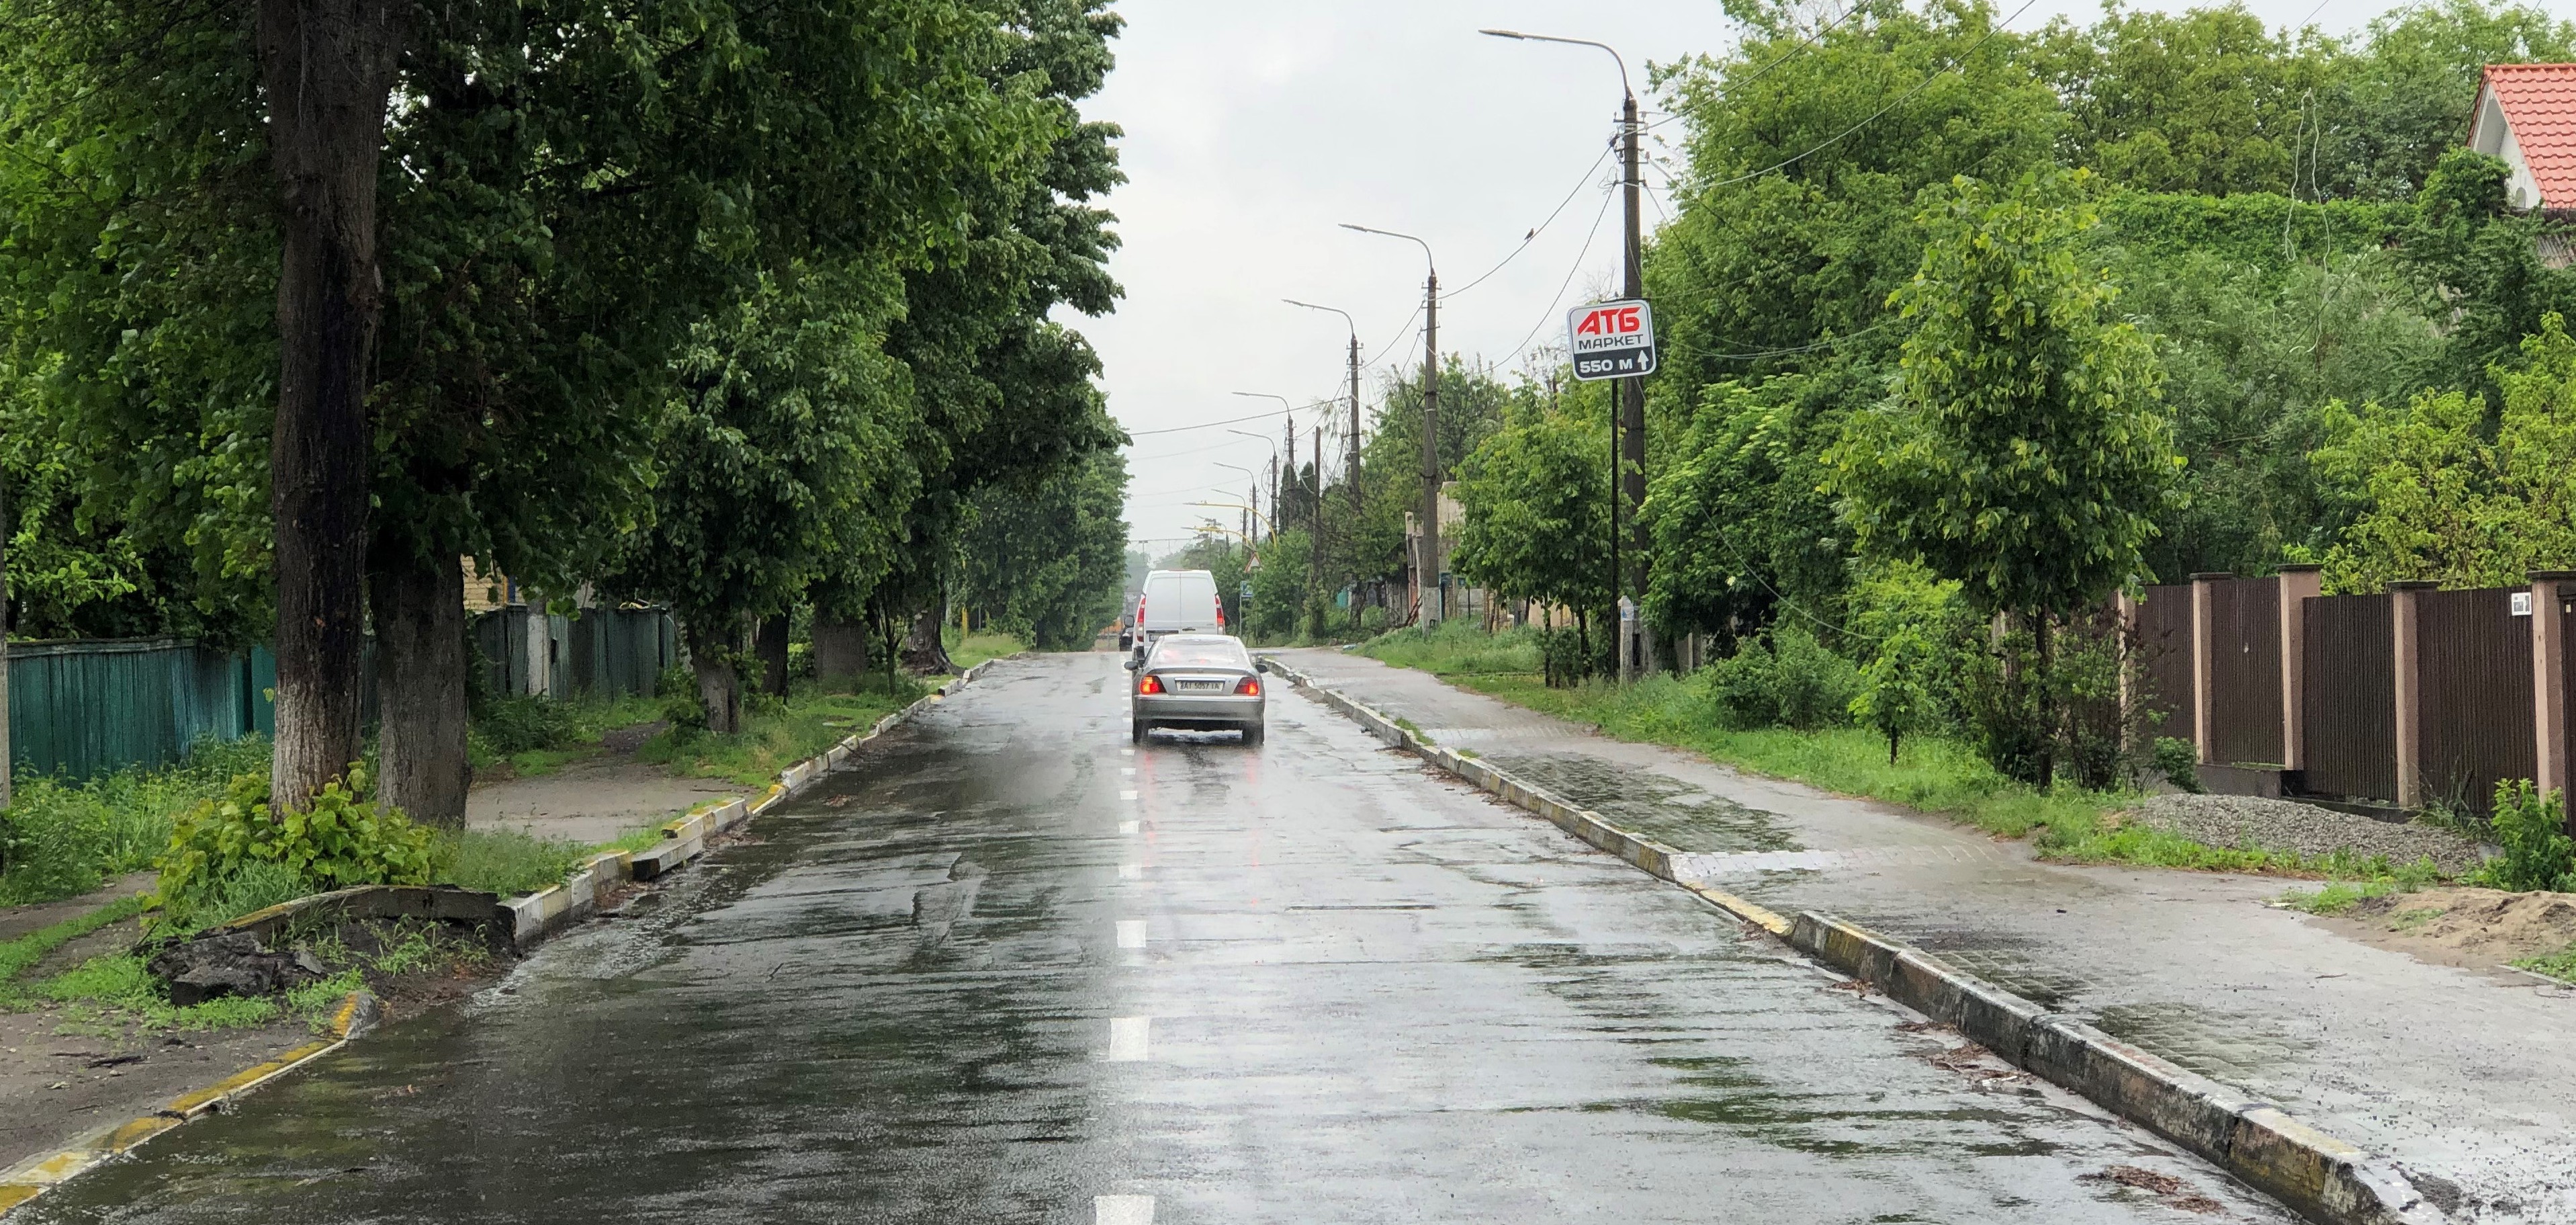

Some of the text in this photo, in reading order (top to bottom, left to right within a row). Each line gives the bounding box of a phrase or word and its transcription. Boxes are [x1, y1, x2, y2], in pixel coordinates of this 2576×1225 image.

[1578, 306, 1641, 335] АТБ
[1579, 334, 1643, 350] МАРКЕТ
[1580, 360, 1613, 373] 550
